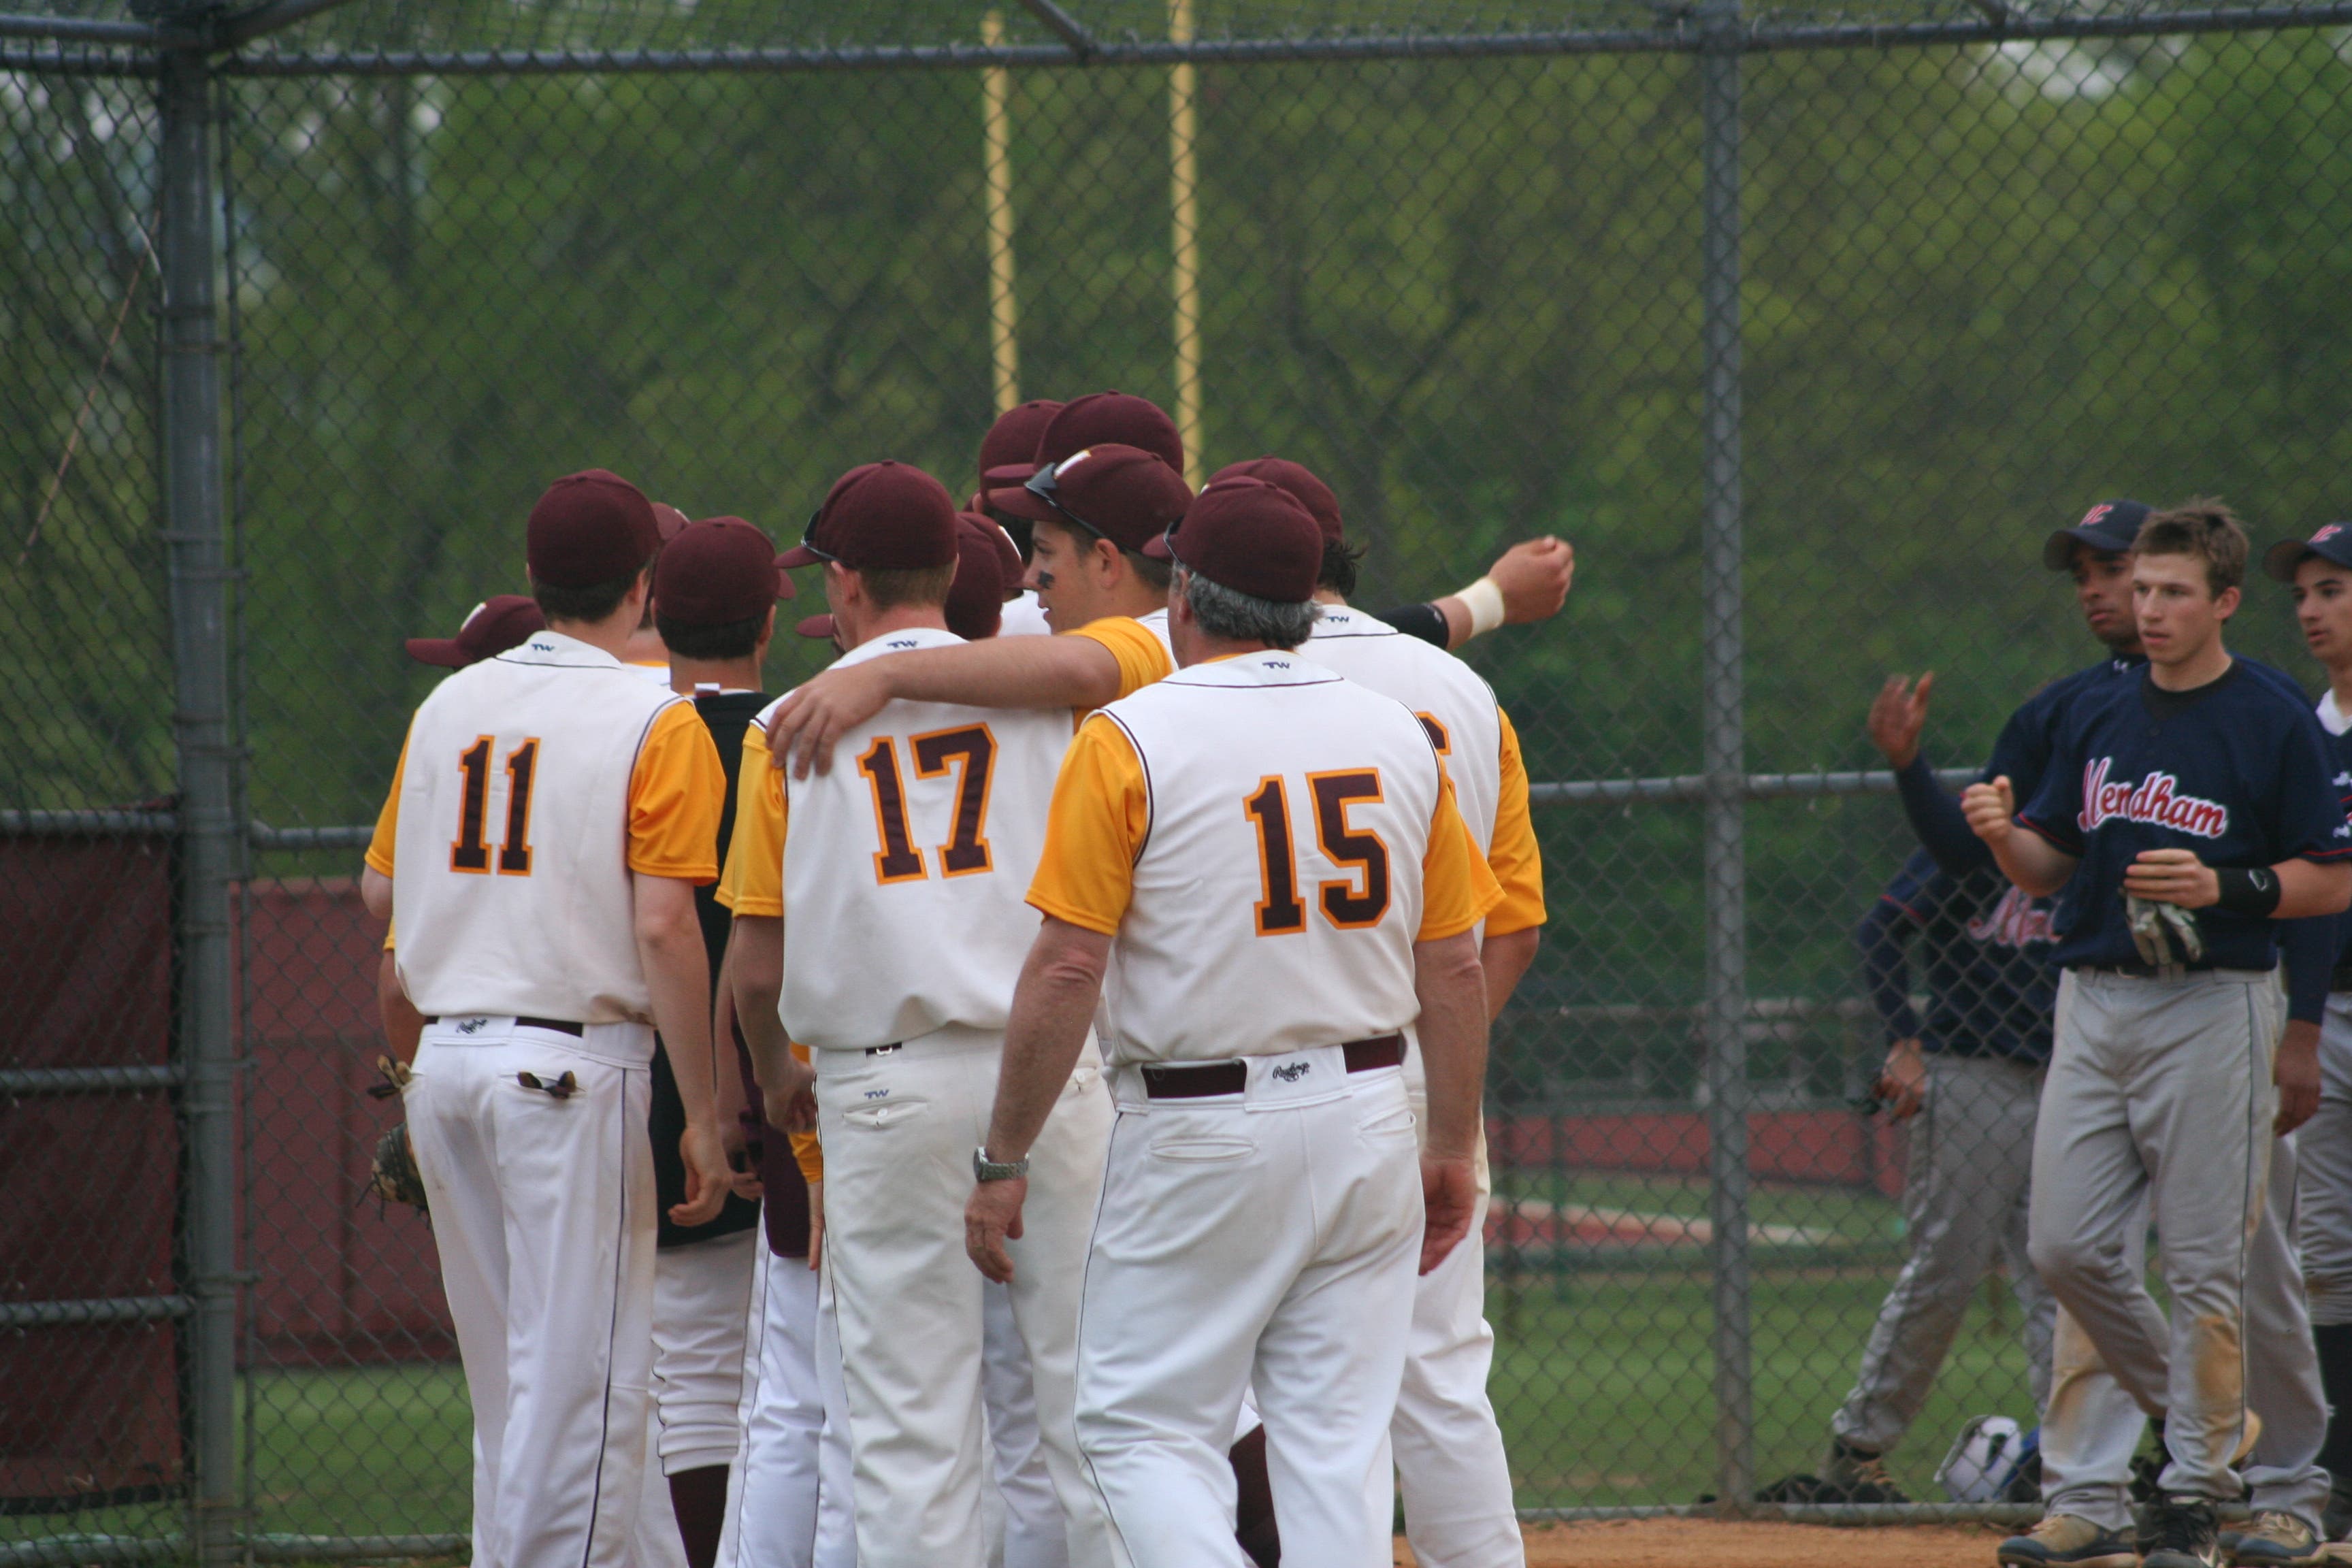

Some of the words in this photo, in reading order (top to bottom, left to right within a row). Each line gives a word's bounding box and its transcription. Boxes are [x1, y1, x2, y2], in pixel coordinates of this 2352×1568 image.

[449, 734, 541, 877] 11
[855, 721, 998, 885] 17
[1242, 767, 1391, 937] 15
[2078, 756, 2228, 839] Mendham
